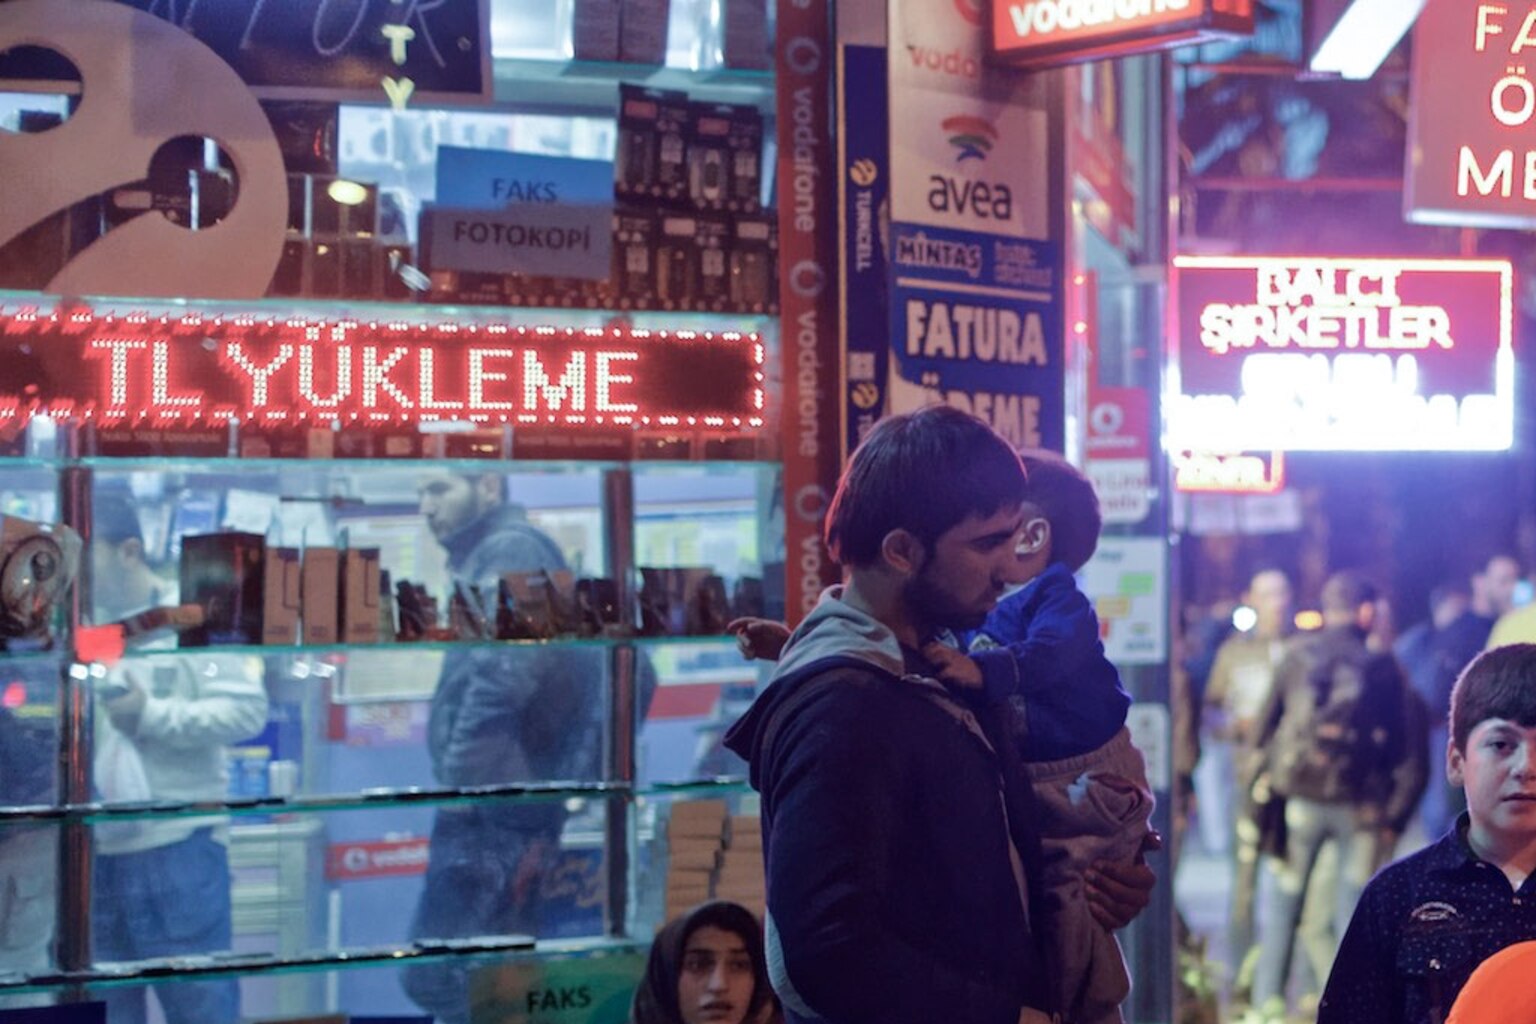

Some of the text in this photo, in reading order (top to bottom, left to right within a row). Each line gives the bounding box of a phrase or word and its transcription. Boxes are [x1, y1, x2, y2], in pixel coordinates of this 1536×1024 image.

[793, 87, 819, 233] vodafone
[491, 177, 557, 203] FAKS
[928, 173, 1013, 221] avea
[453, 220, 591, 251] FOTOKOPİ
[906, 300, 1048, 366] FATURA
[91, 325, 640, 412] TL YÜKLEME
[526, 985, 592, 1014] FAKS
